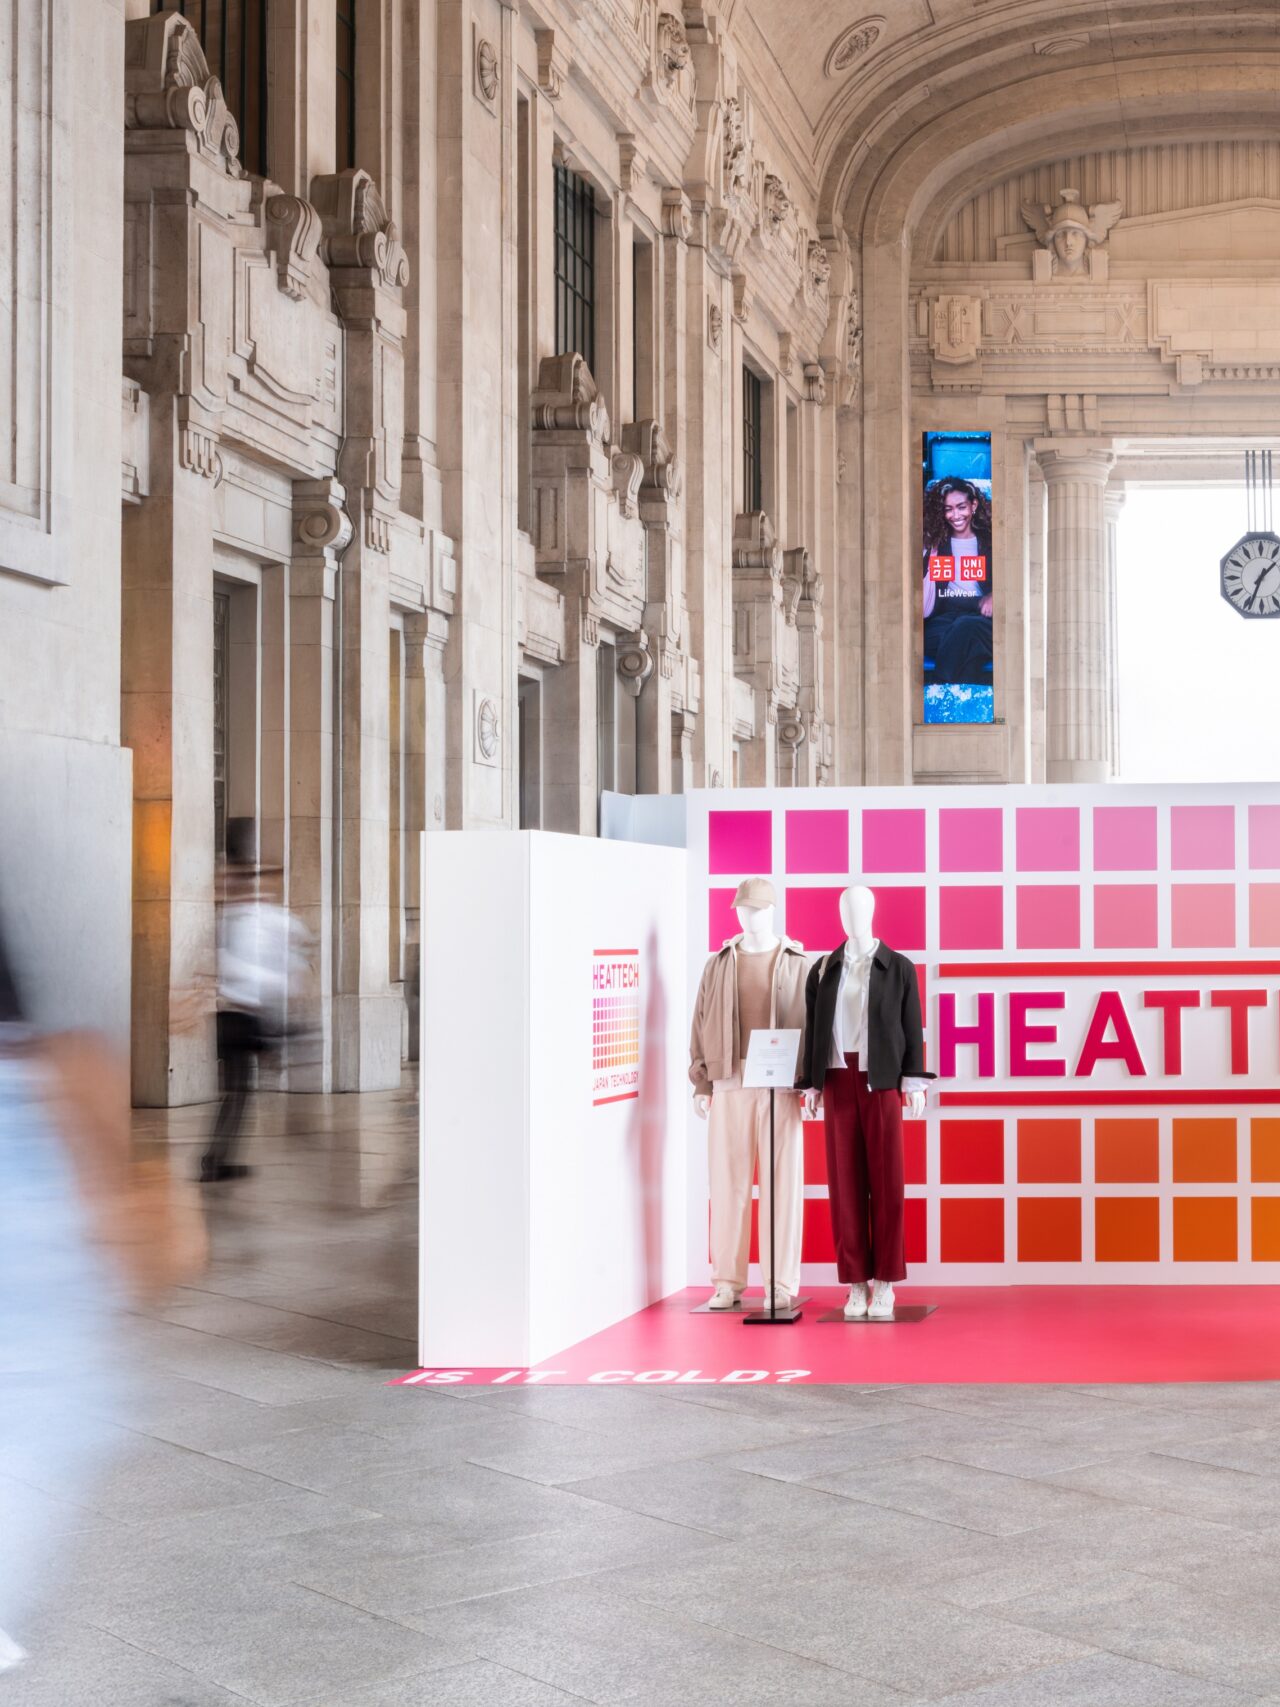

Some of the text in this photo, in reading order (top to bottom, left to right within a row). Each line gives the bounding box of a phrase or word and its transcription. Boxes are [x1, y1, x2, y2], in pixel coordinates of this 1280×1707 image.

[938, 588, 977, 598] LifeWear
[592, 959, 639, 989] HEATTECH
[593, 1071, 639, 1091] JAPAN TECHNOLOGY
[402, 1369, 812, 1384] IS IT COLD?
